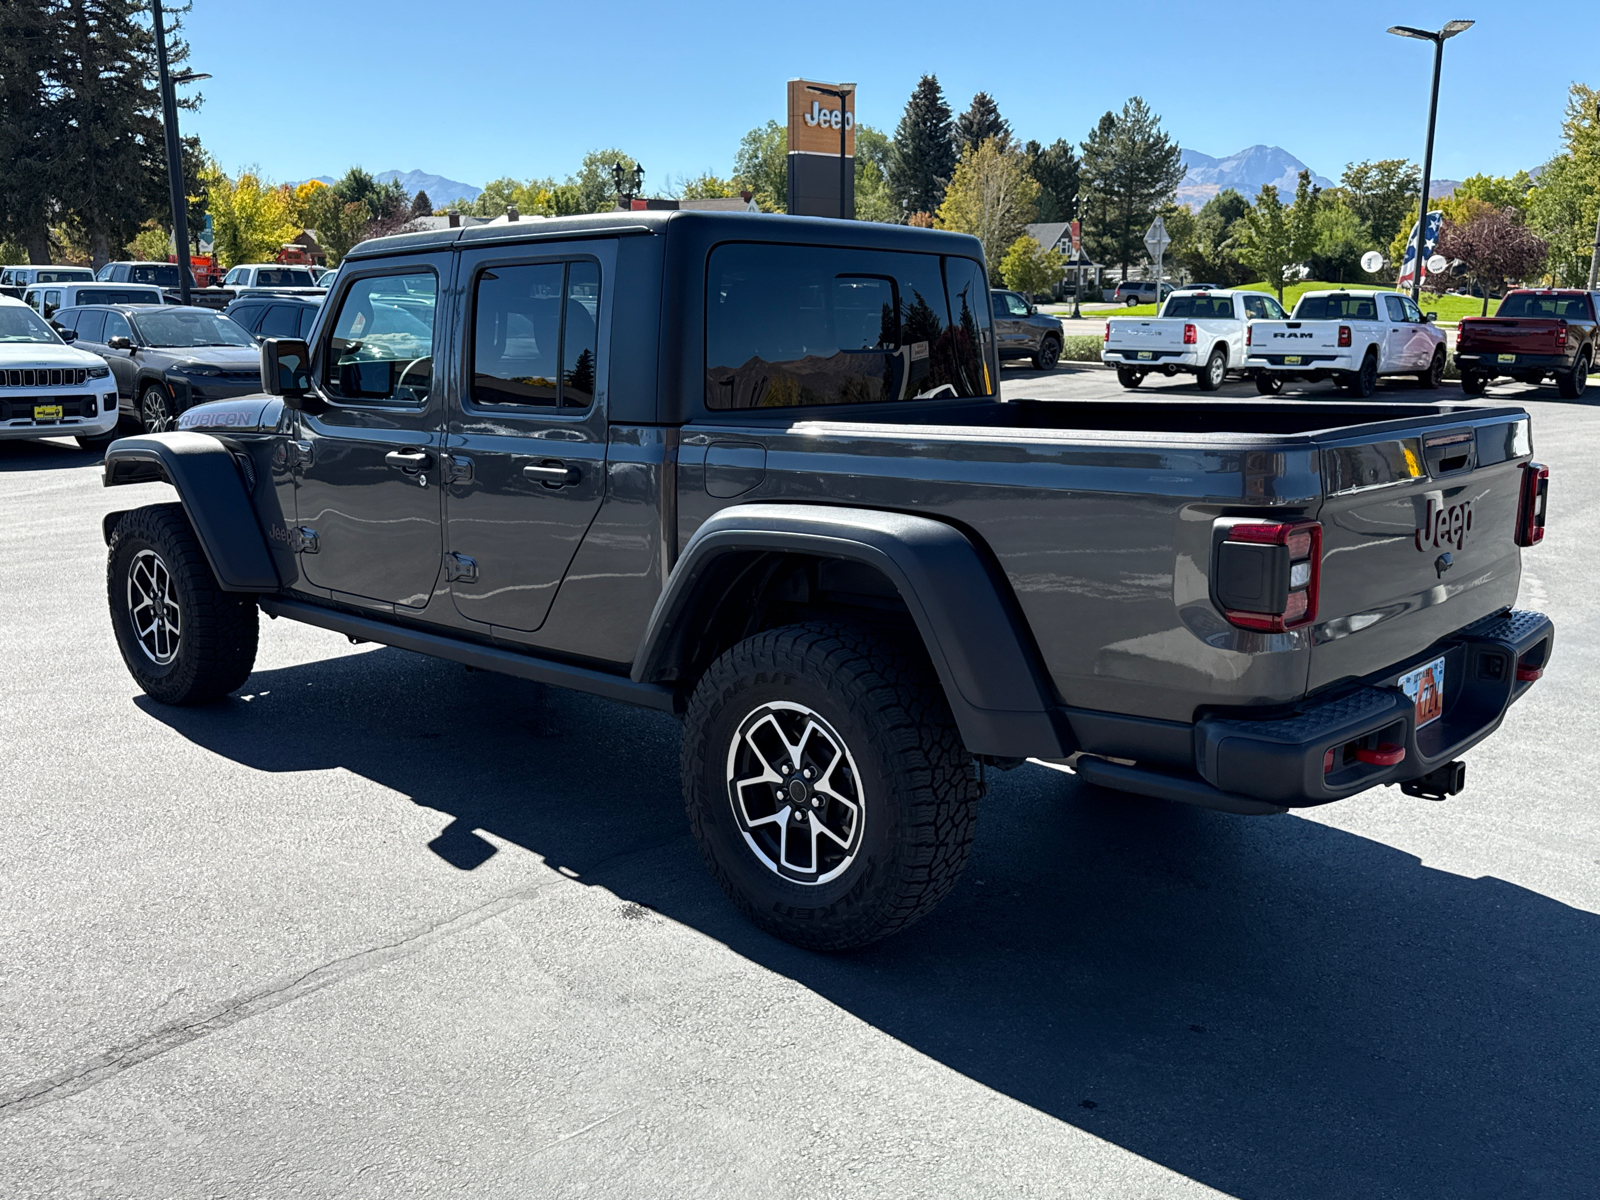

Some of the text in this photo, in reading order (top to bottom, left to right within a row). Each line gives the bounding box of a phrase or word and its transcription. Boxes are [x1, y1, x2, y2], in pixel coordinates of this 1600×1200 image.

[804, 100, 853, 131] Jeep
[179, 412, 252, 426] RUBICON
[269, 523, 293, 544] Jeep
[1414, 498, 1476, 553] Jeep
